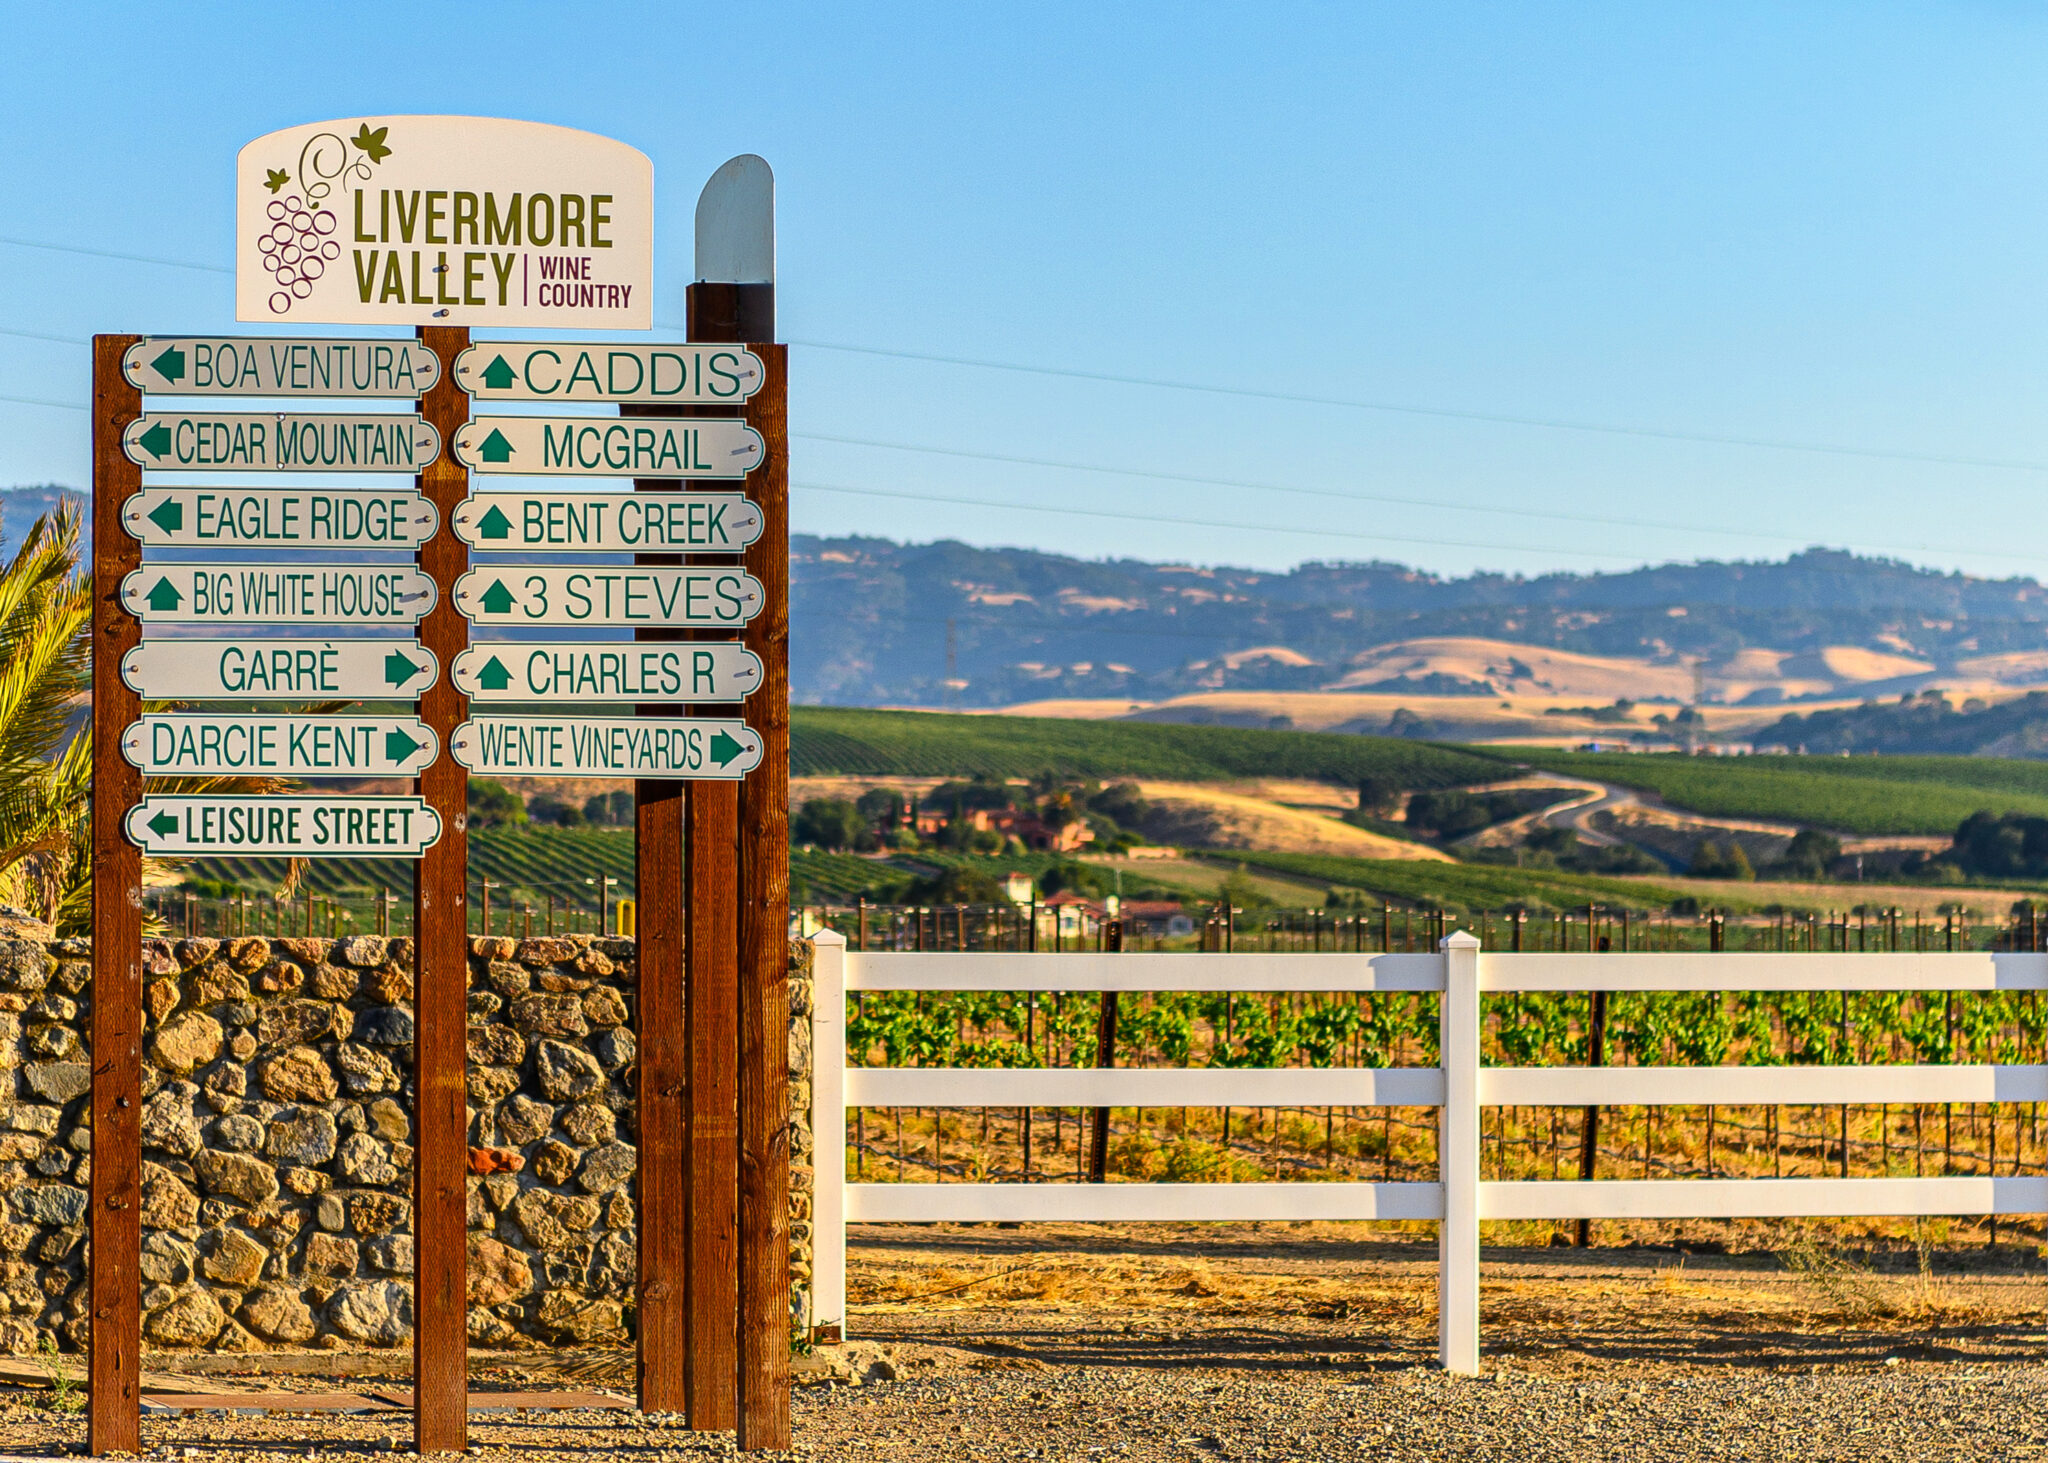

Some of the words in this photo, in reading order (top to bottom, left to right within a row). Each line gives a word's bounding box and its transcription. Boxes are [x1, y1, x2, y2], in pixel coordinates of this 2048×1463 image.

[354, 189, 613, 248] LIVERMORE
[353, 250, 516, 306] VALLEY
[539, 256, 591, 281] WINE
[539, 284, 632, 308] COUNTRY
[195, 344, 260, 388] BOA
[270, 345, 415, 390] VENTURA
[524, 350, 740, 397] CADDIS
[176, 419, 266, 464] CEDAR
[277, 421, 413, 466] MOUNTAIN
[544, 425, 712, 470] MCGRAIL
[197, 495, 299, 539] EAGLE
[311, 497, 409, 541] RIDGE
[523, 500, 608, 543] BENT
[619, 501, 729, 545] CREEK
[194, 572, 233, 615] BIG
[240, 572, 314, 615] WHITE
[322, 573, 404, 616] HOUSE
[523, 576, 548, 618] 3
[566, 575, 742, 620] STEVES
[527, 650, 680, 694] CHARLES
[694, 652, 715, 694] R
[153, 723, 277, 767] DARCIE
[290, 724, 377, 768] KENT
[480, 724, 563, 767] WENTE
[572, 725, 702, 770] VINEYARDS
[186, 807, 301, 845] LEISURE
[313, 807, 415, 845] STREET
